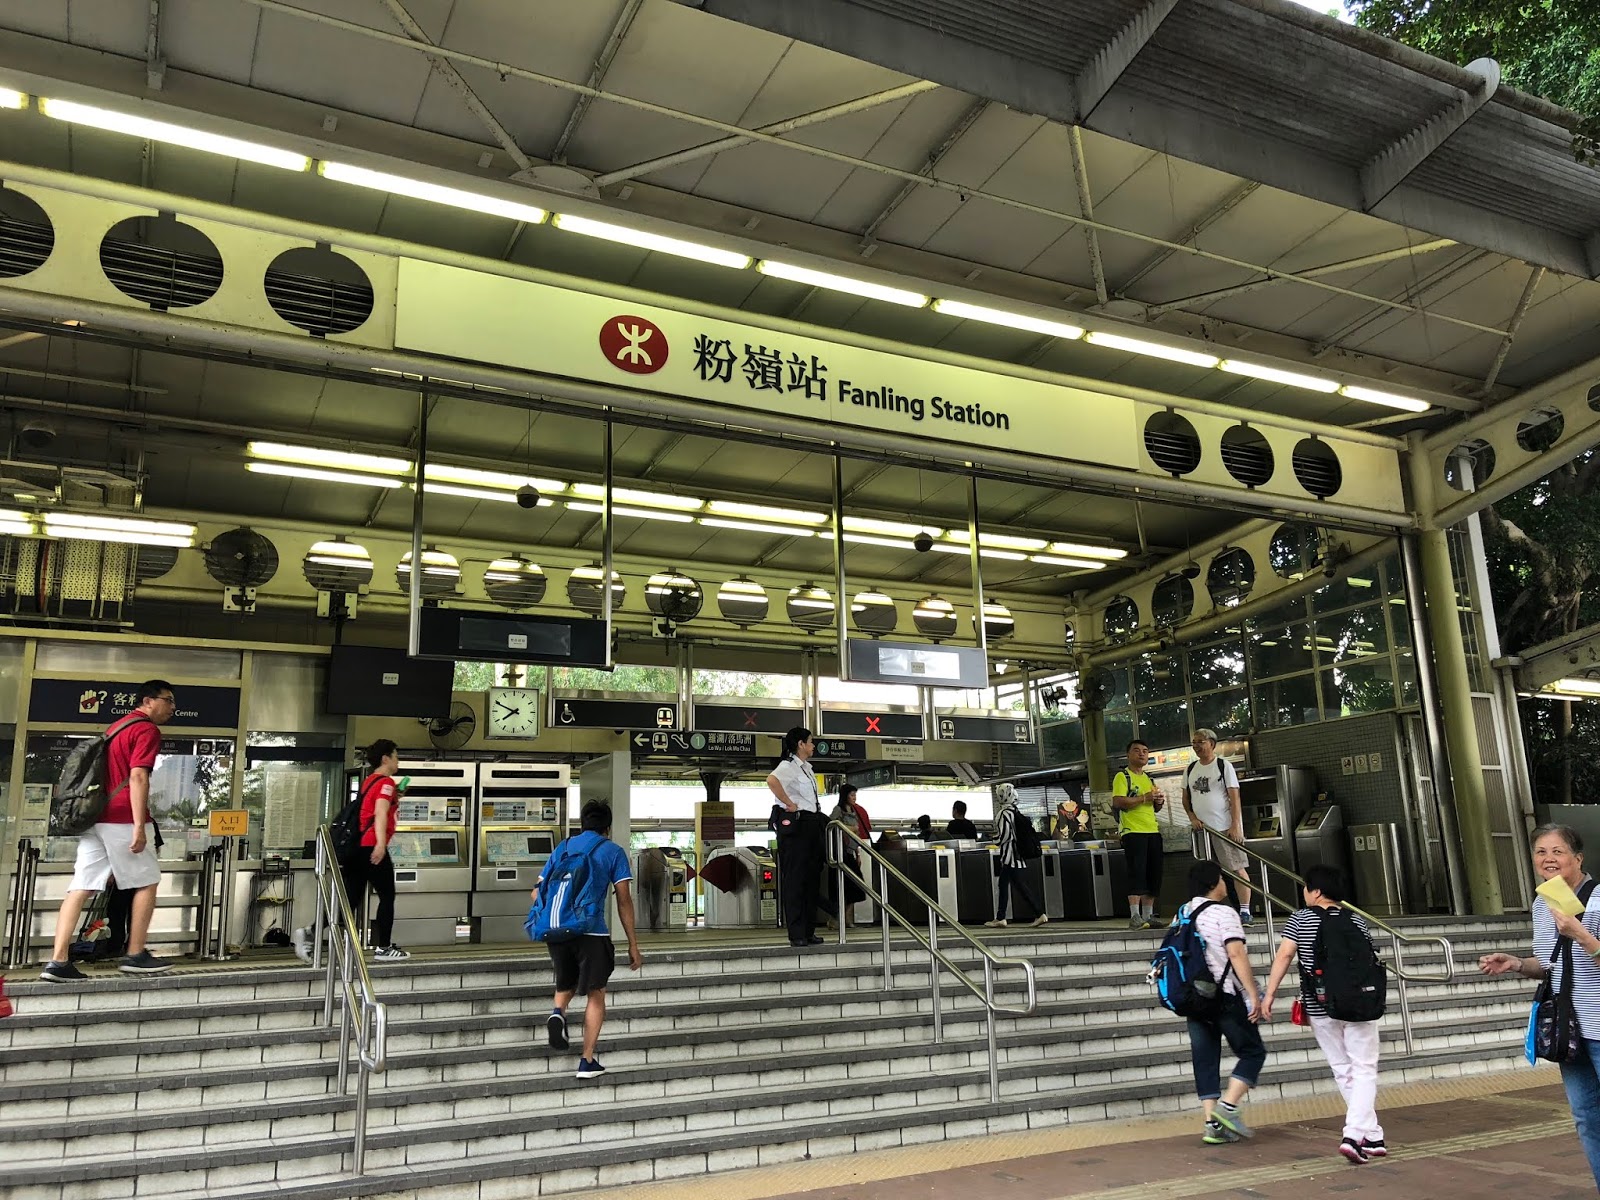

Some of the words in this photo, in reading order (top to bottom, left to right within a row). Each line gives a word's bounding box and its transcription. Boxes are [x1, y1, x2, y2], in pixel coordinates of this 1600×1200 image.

[693, 334, 829, 401] 粉嶺站
[838, 380, 925, 421] Fanling
[931, 396, 1010, 430] Station
[110, 707, 131, 715] Custo
[174, 709, 199, 718] Centre
[219, 816, 239, 824] 入口
